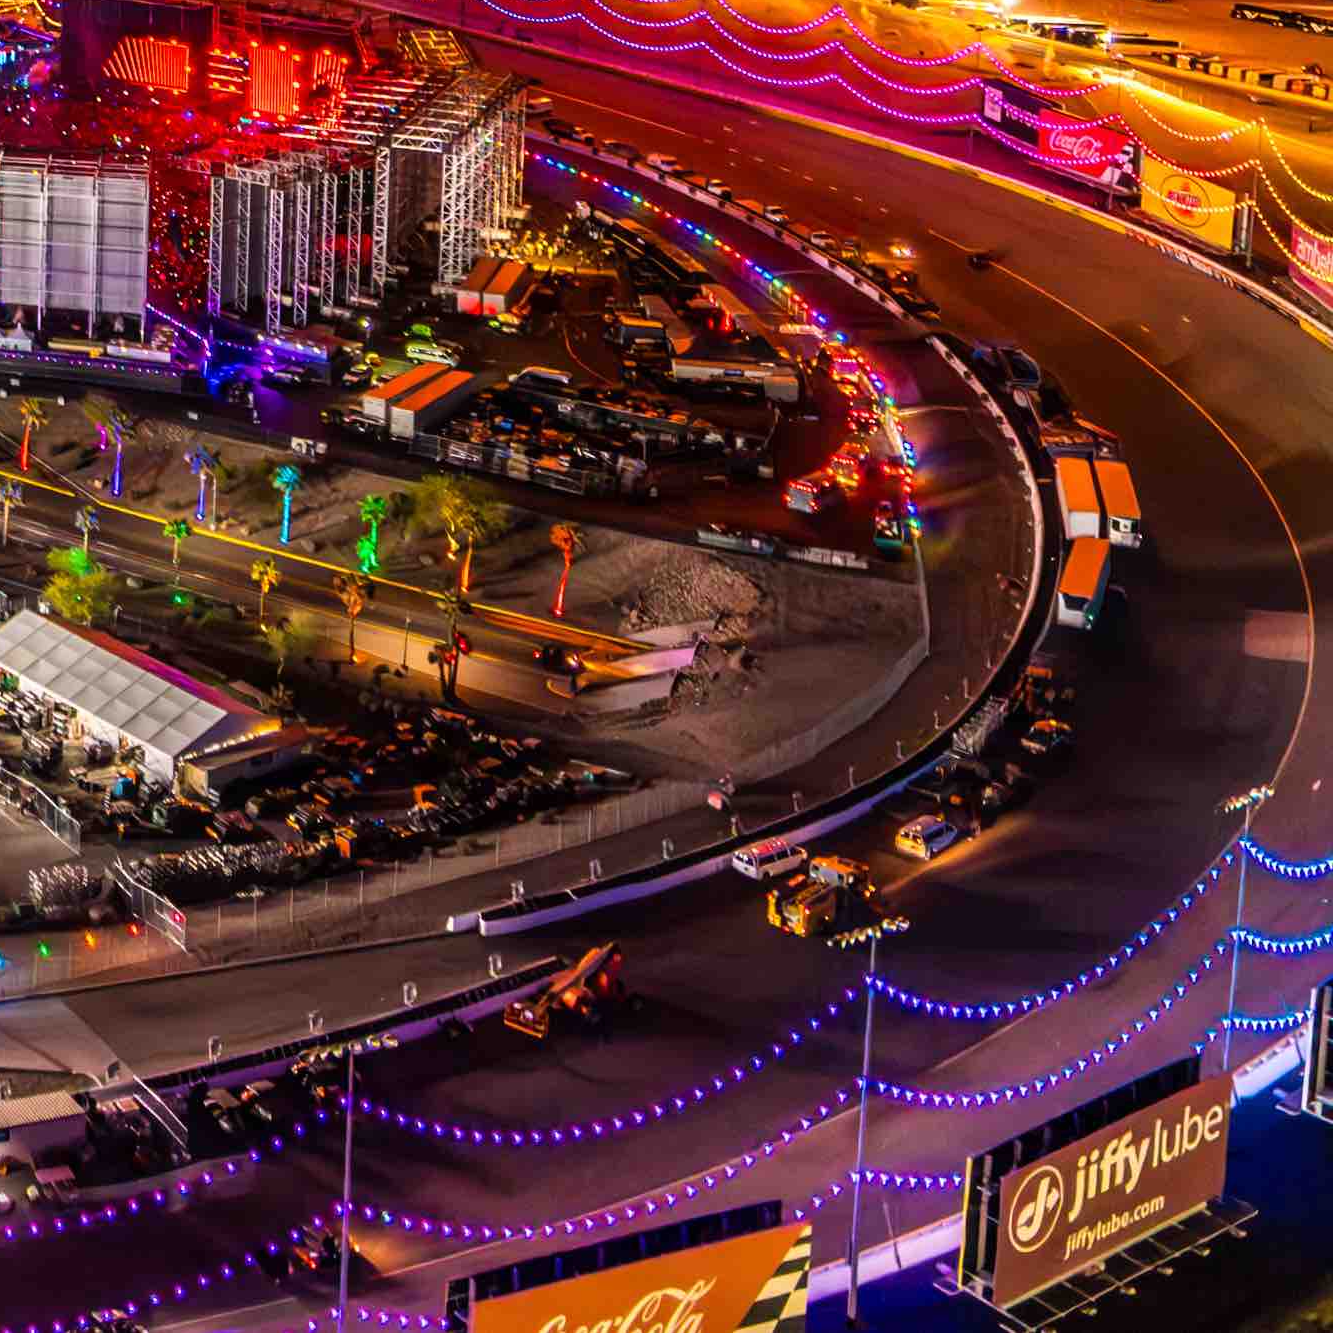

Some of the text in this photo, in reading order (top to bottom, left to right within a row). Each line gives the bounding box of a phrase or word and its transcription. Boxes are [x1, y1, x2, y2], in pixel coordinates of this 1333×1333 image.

[1068, 1104, 1223, 1223] jiffy lube
[1063, 1195, 1166, 1261] jiffylube.com
[538, 1275, 718, 1333] Ca-Cla
